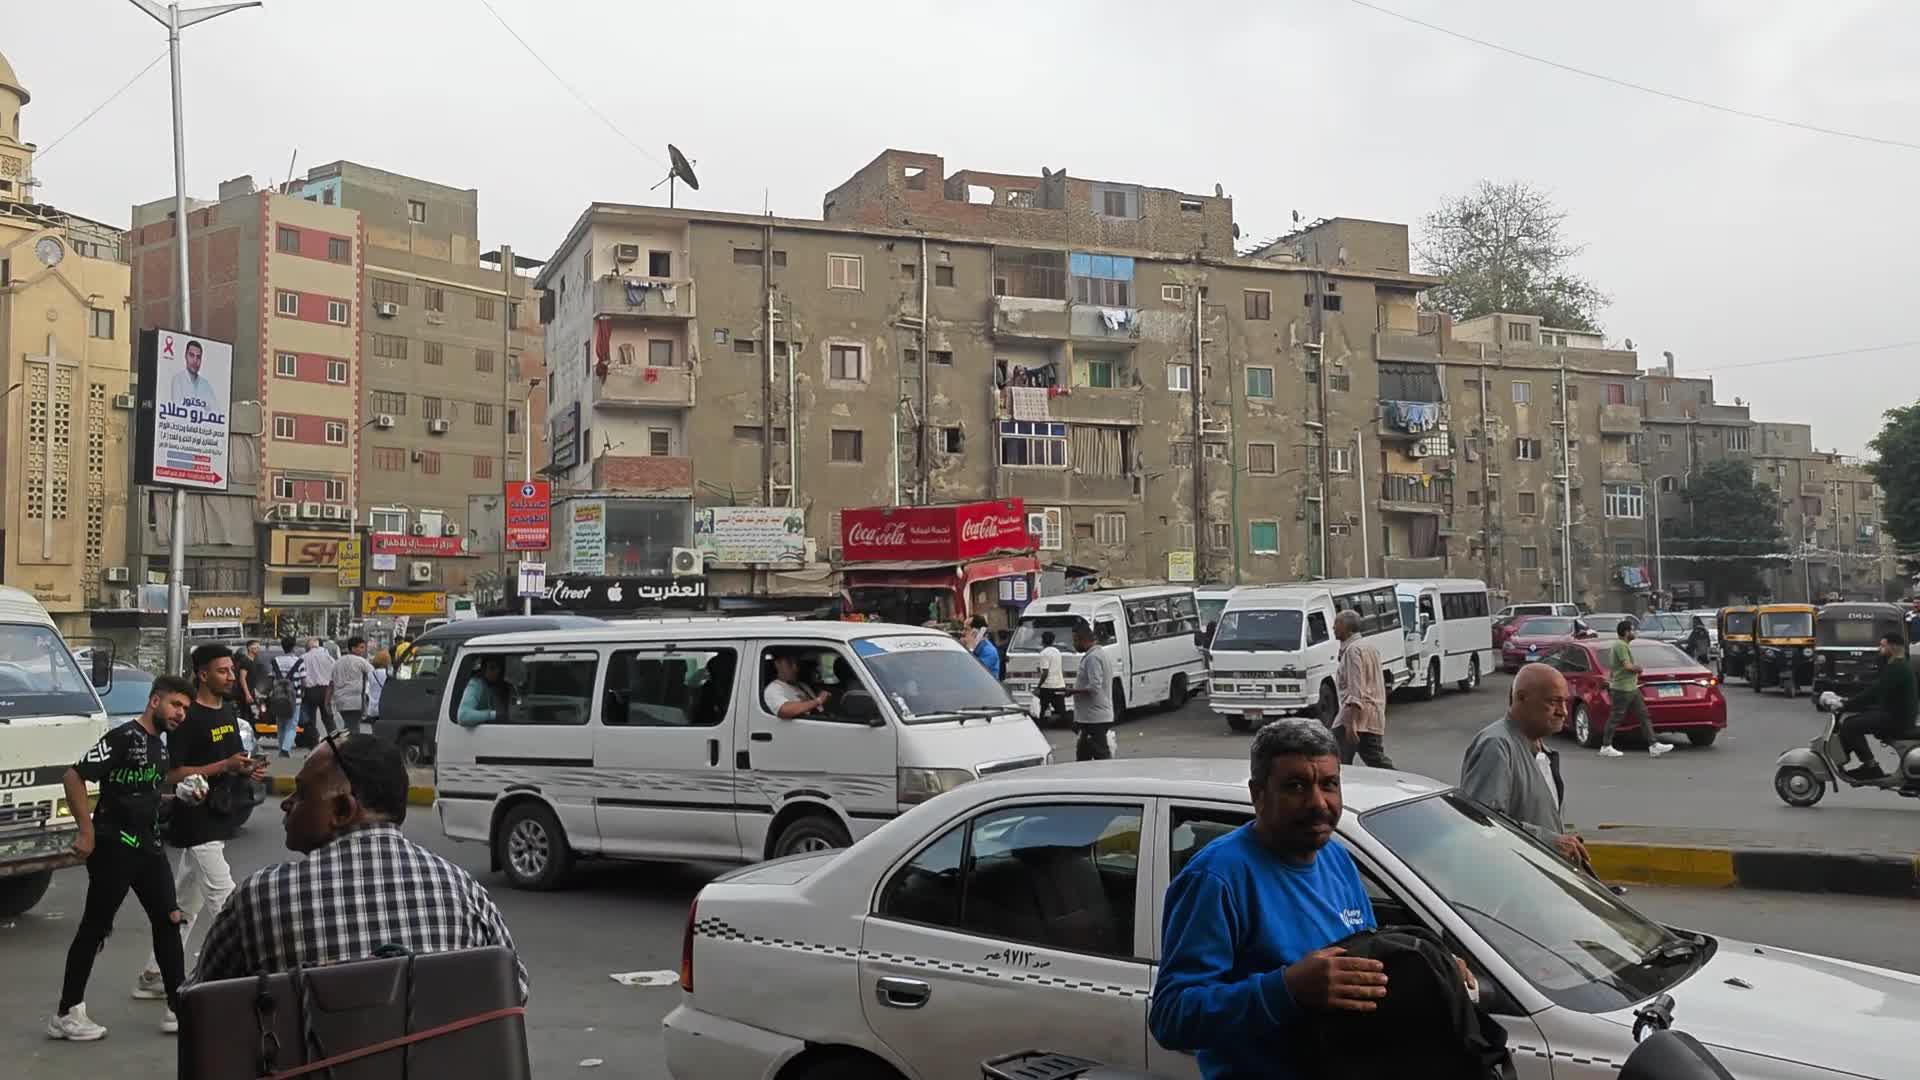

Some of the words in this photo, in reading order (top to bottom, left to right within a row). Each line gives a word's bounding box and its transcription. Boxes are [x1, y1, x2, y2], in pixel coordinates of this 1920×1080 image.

[159, 402, 188, 420] صلاح
[182, 397, 207, 408] دكتور
[190, 409, 225, 425] عمرو
[849, 521, 908, 546] Coca-Cola
[638, 581, 705, 601] العفريت
[204, 607, 242, 617] MRMR
[1003, 948, 1036, 968] ٩٧١٣
